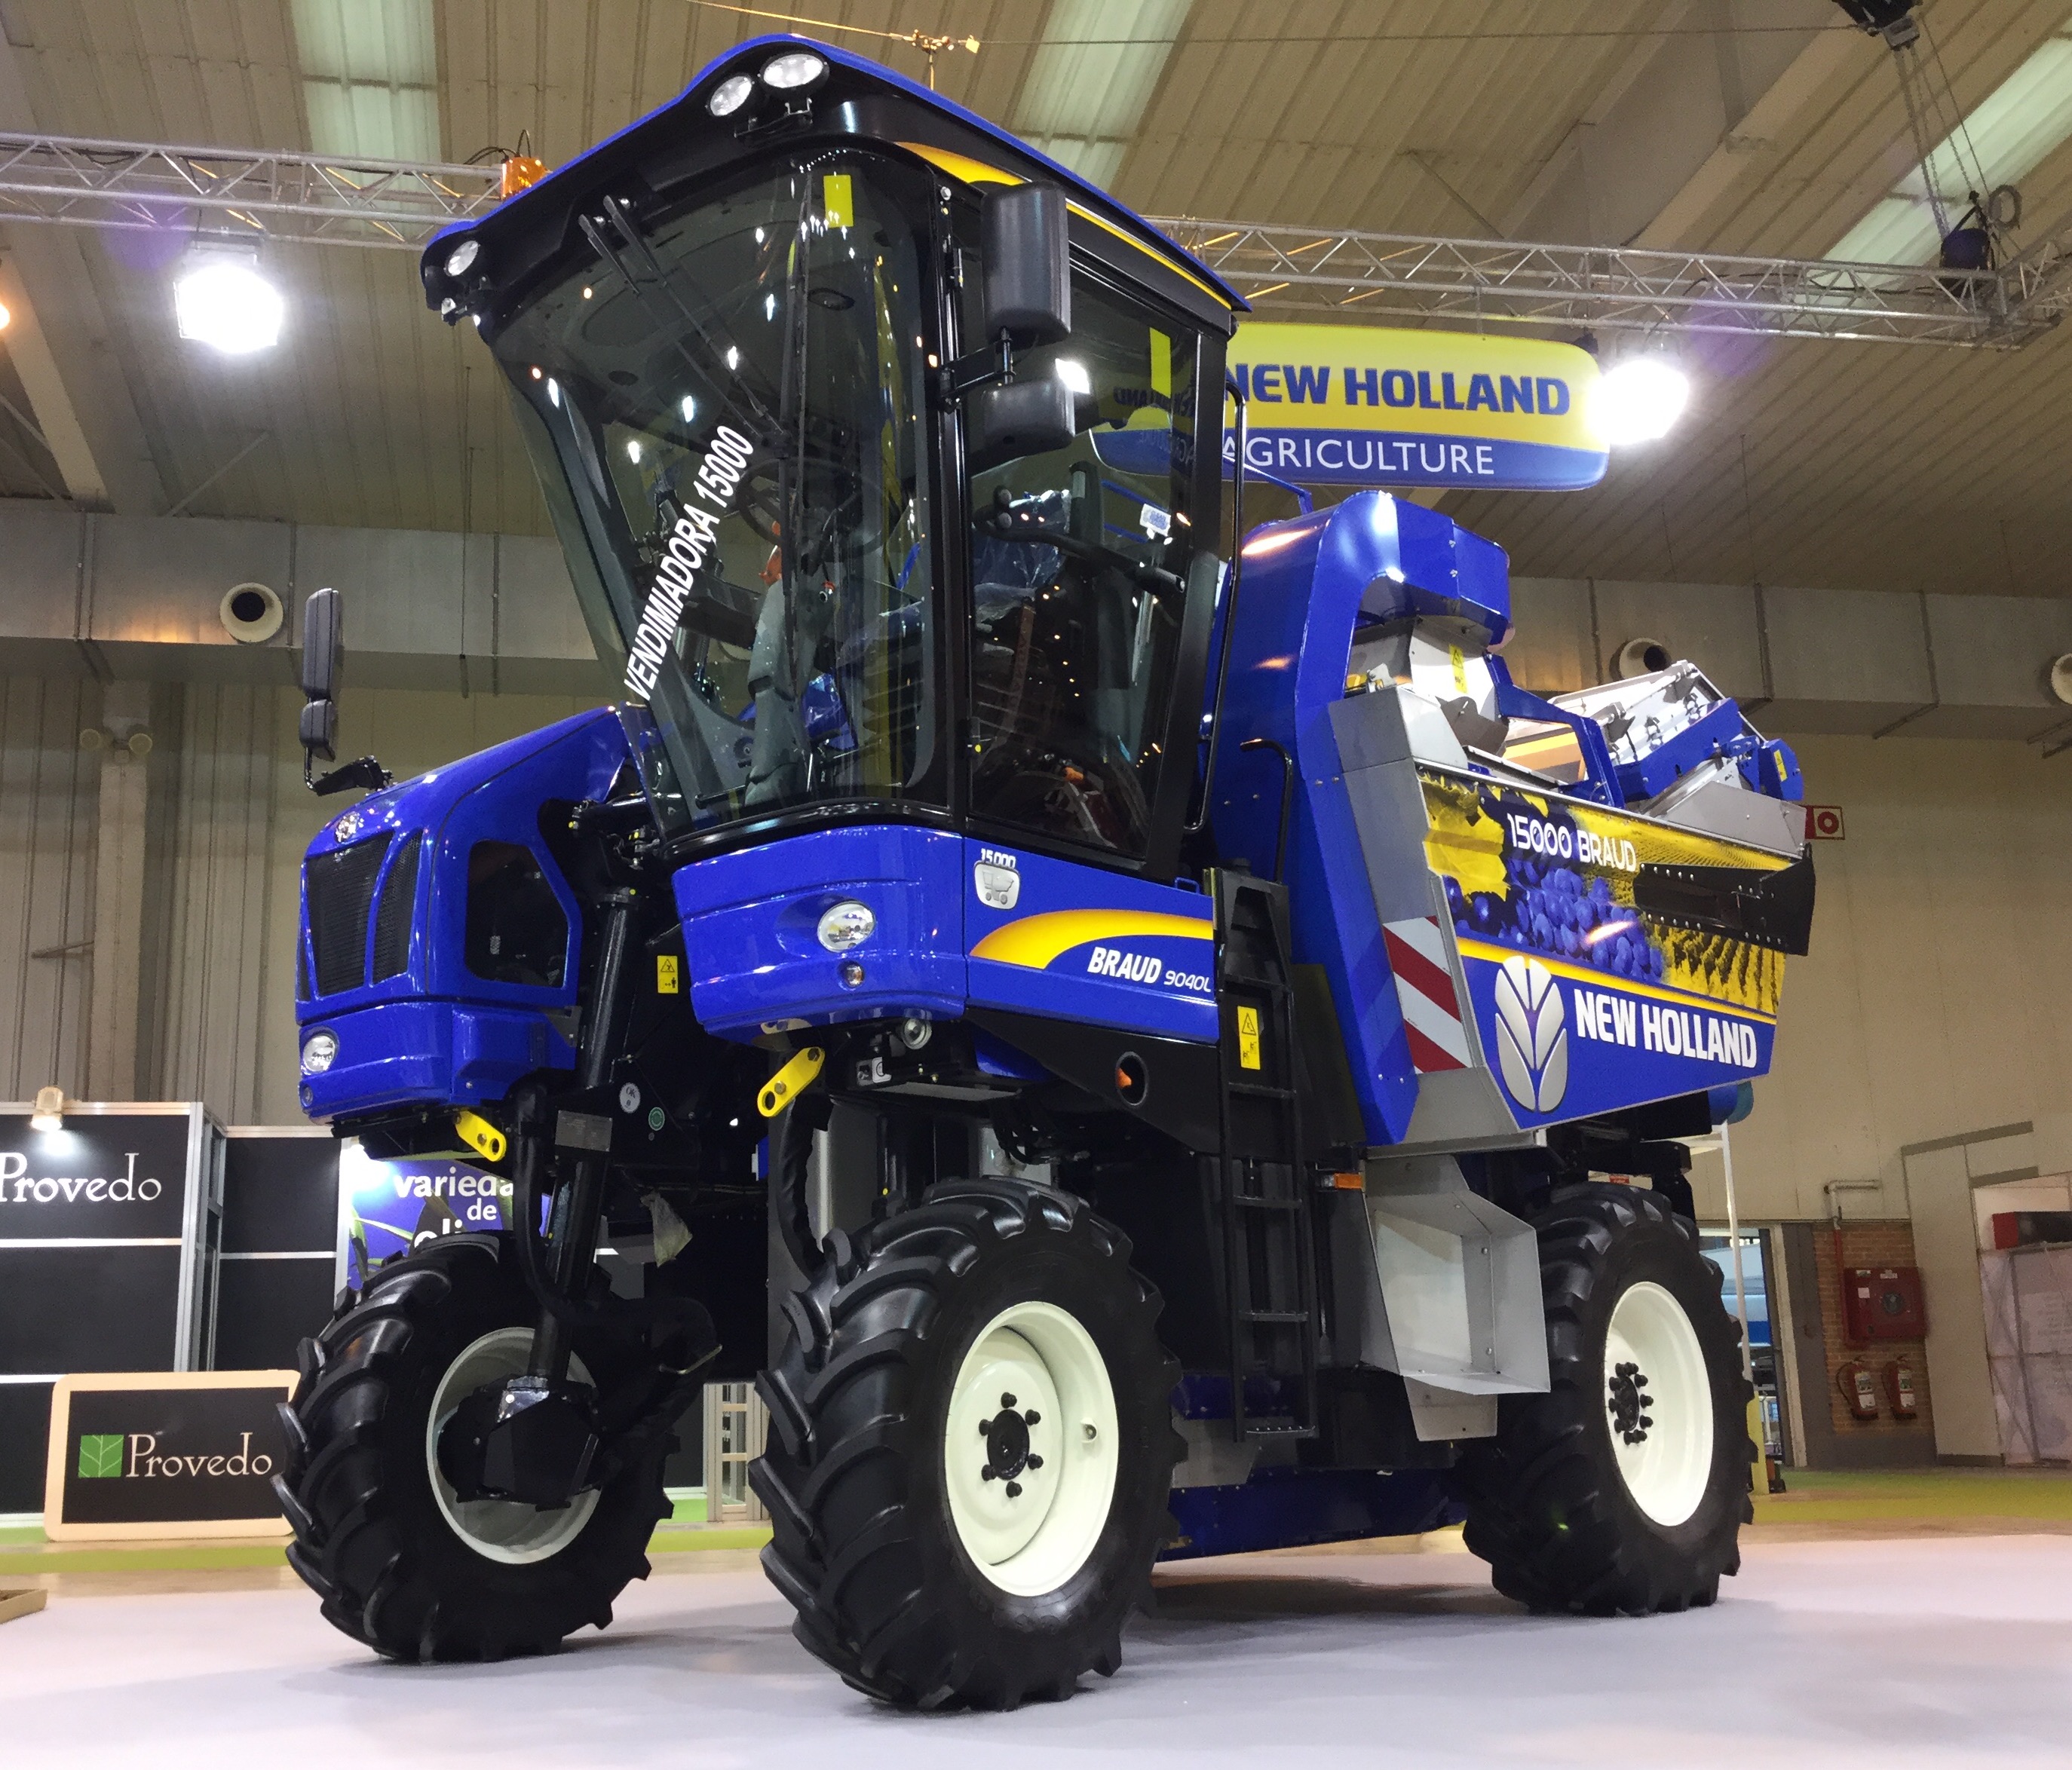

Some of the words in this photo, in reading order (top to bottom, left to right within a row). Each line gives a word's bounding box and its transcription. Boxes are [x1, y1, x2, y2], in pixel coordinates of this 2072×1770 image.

[1225, 363, 1331, 404] NEW
[1344, 367, 1571, 415] HOLLAND
[1223, 436, 1494, 475] AGRICULTURE
[624, 503, 720, 701] VENDIMIADORA
[693, 425, 753, 508] 15000
[981, 847, 1016, 868] 15000
[1507, 813, 1572, 859] 15000
[1577, 829, 1636, 872] BRAUD
[1087, 946, 1162, 984] BRAUD
[1163, 970, 1212, 993] 9040L
[1574, 988, 1636, 1047] NEW
[1641, 1003, 1758, 1068] HOLLAND
[0, 1152, 161, 1202] Provedo
[393, 1165, 514, 1198] varieda
[467, 1198, 497, 1221] de
[126, 1432, 272, 1478] Provedo
